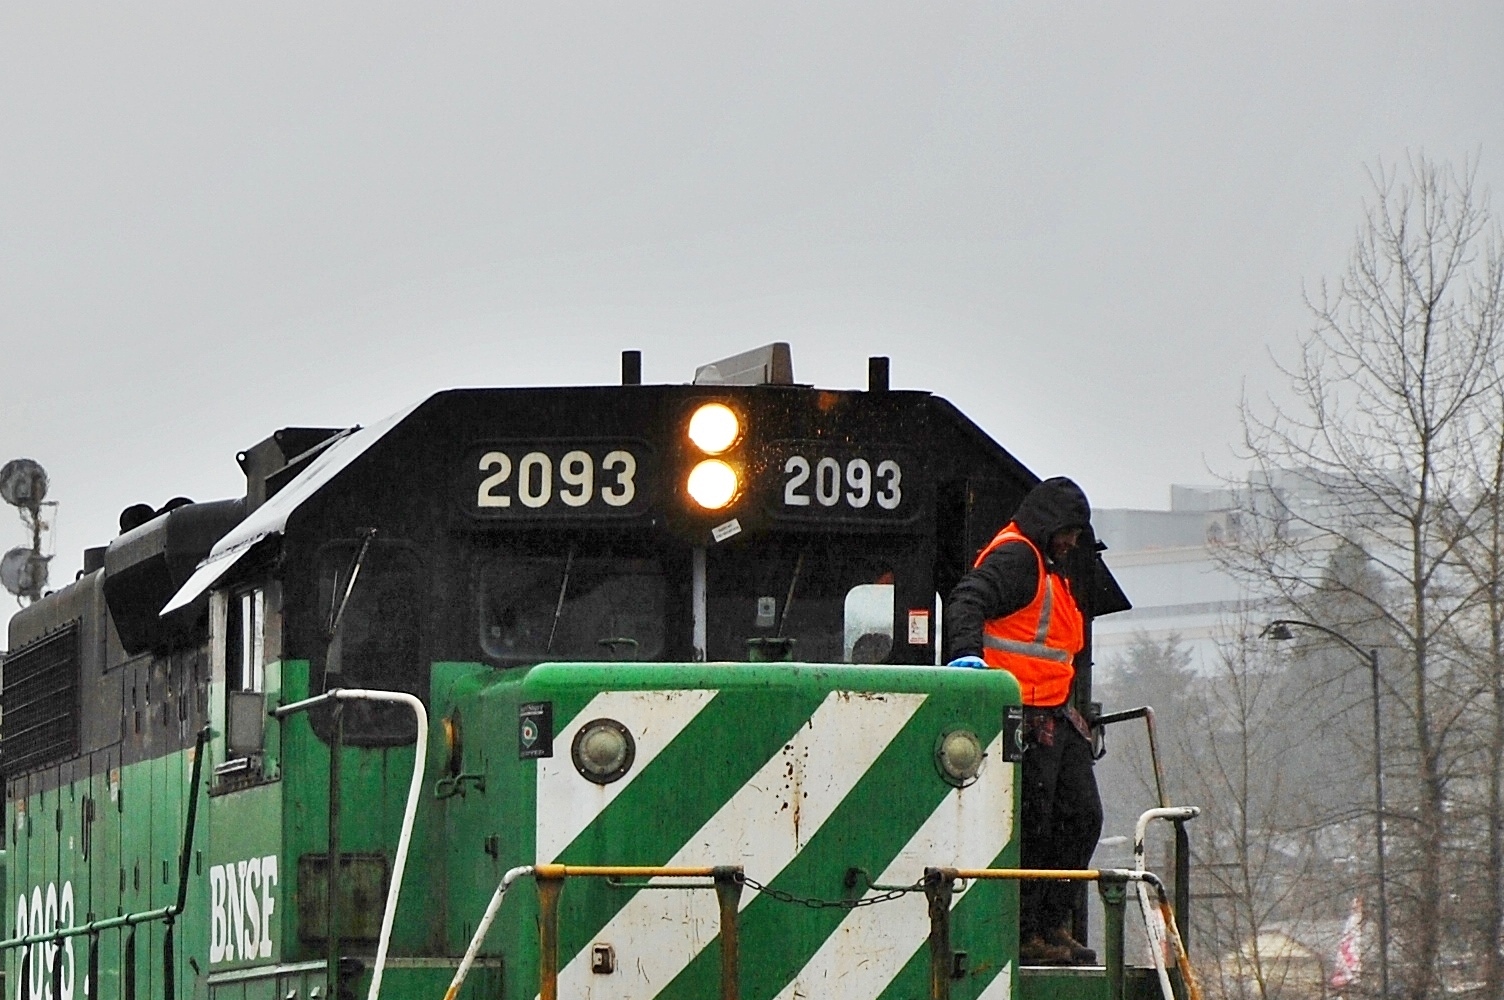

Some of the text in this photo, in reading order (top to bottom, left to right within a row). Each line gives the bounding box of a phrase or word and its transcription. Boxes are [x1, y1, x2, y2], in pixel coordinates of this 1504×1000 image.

[477, 450, 637, 508] 2093
[784, 455, 902, 510] 2093
[209, 854, 278, 964] BNSF
